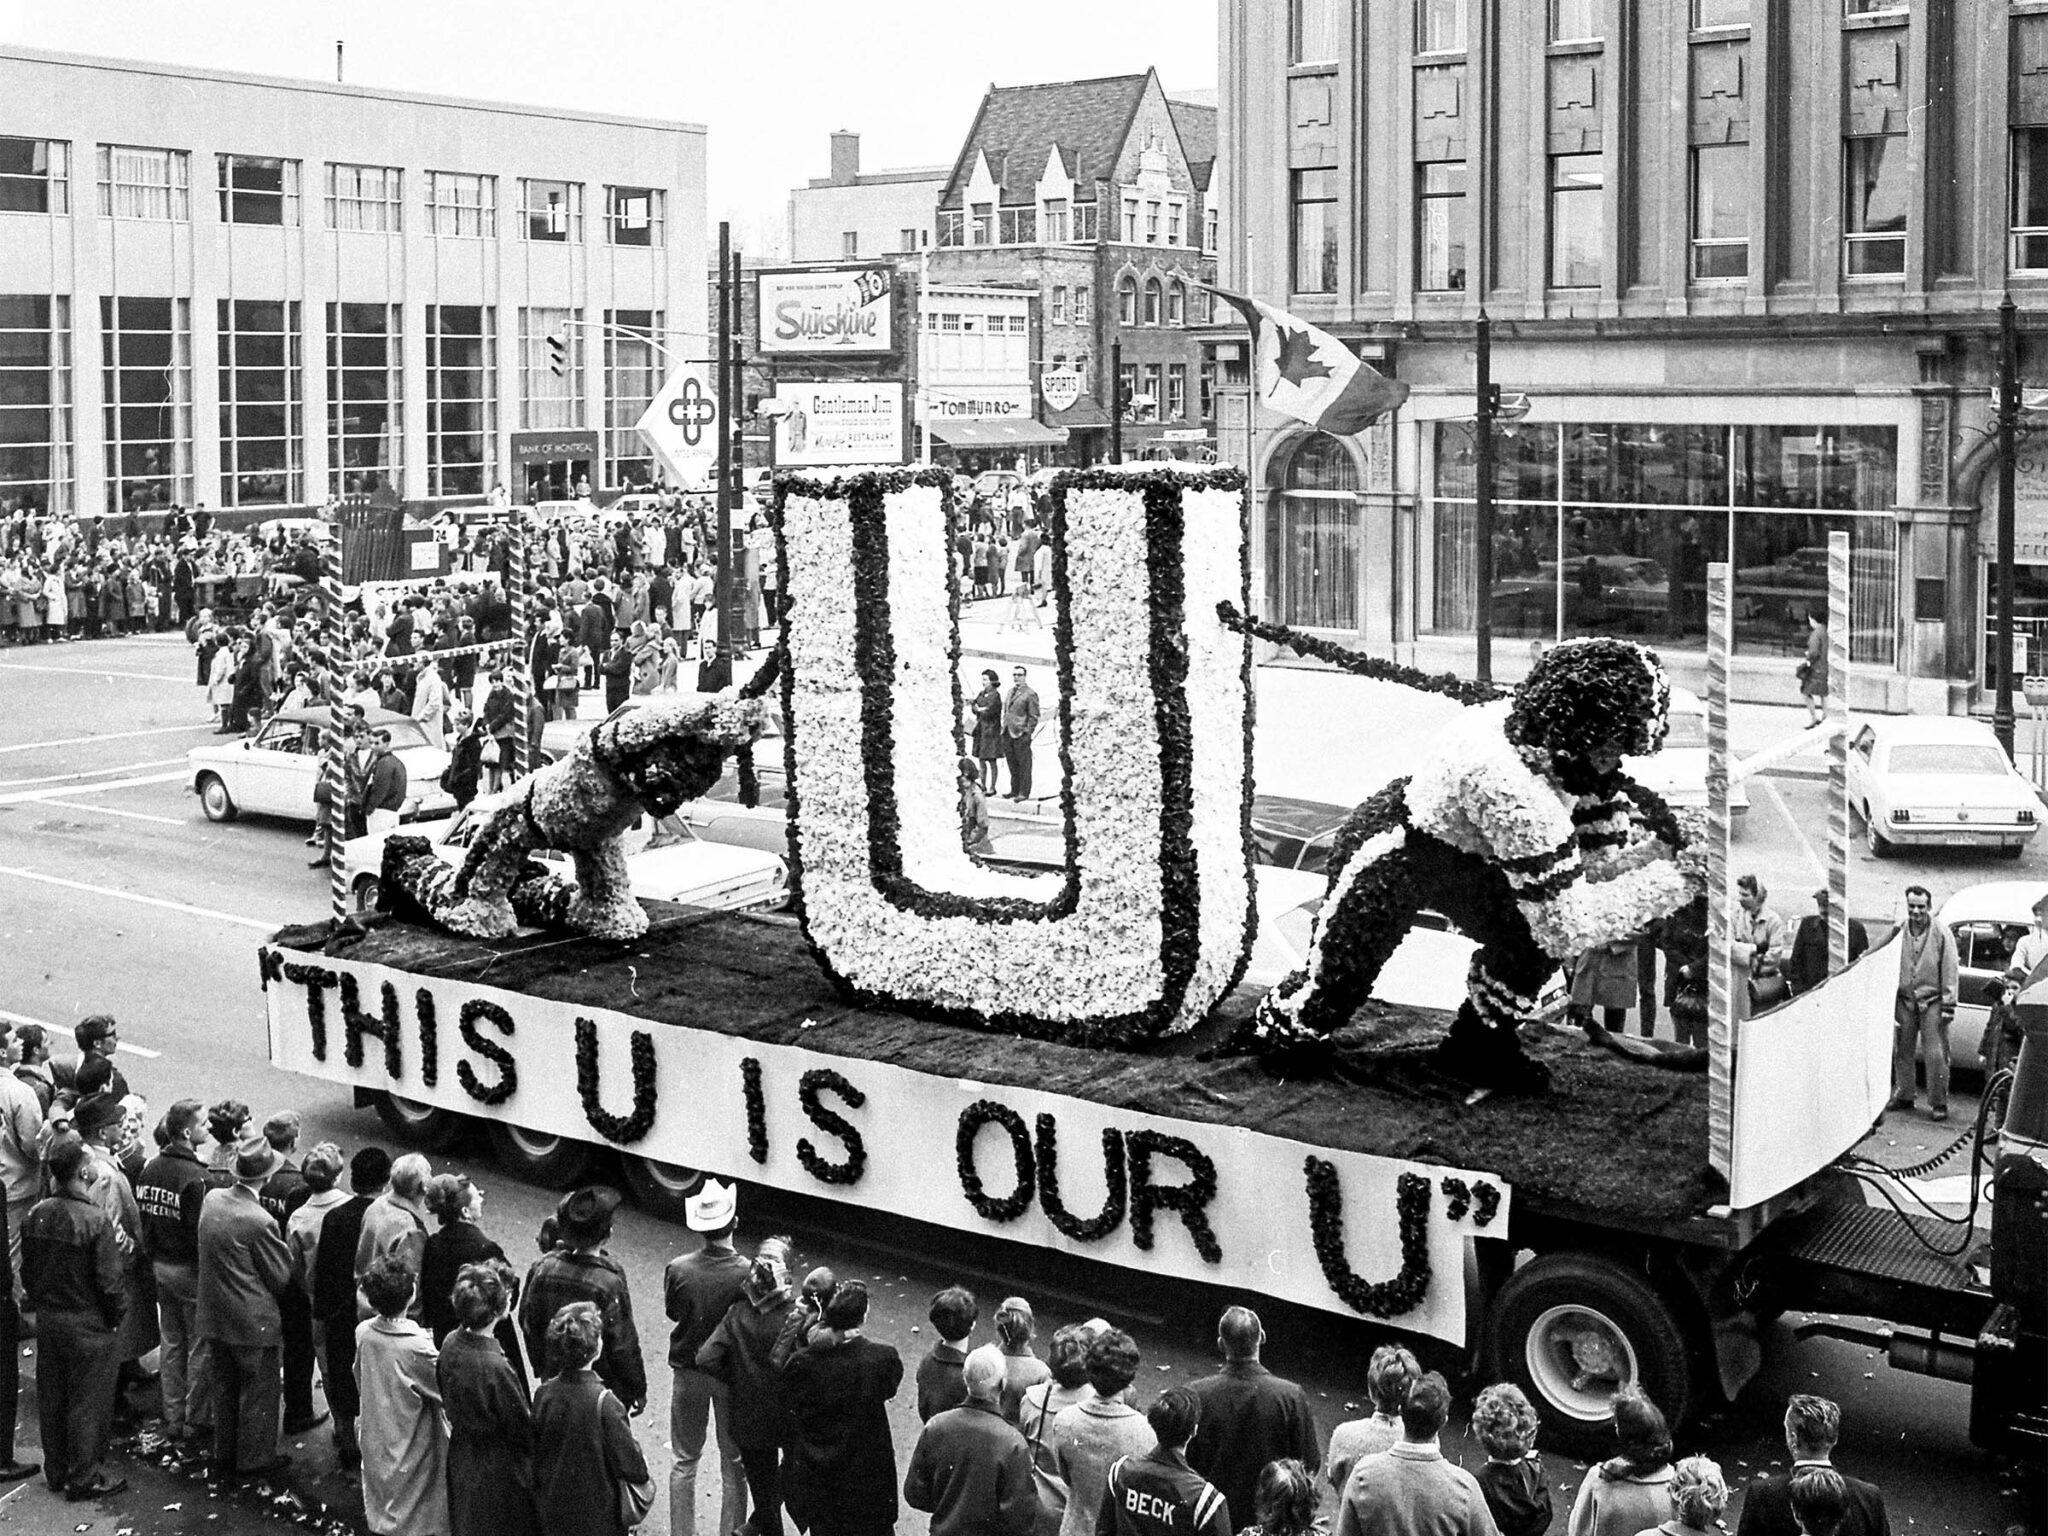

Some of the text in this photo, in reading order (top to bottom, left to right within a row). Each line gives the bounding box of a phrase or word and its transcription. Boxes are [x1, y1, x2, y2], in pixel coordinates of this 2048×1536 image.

[775, 300, 876, 340] Sunshine
[1045, 376, 1077, 392] SPORTS
[813, 393, 892, 414] Gentleman Jim
[519, 443, 594, 454] BANK OF MONTREAL
[436, 530, 446, 542] 24
[575, 1017, 658, 1145] U
[739, 1057, 867, 1185] IS
[956, 1100, 1223, 1264] OUR
[136, 1184, 181, 1209] WESTERN
[1126, 1488, 1176, 1526] BECK
